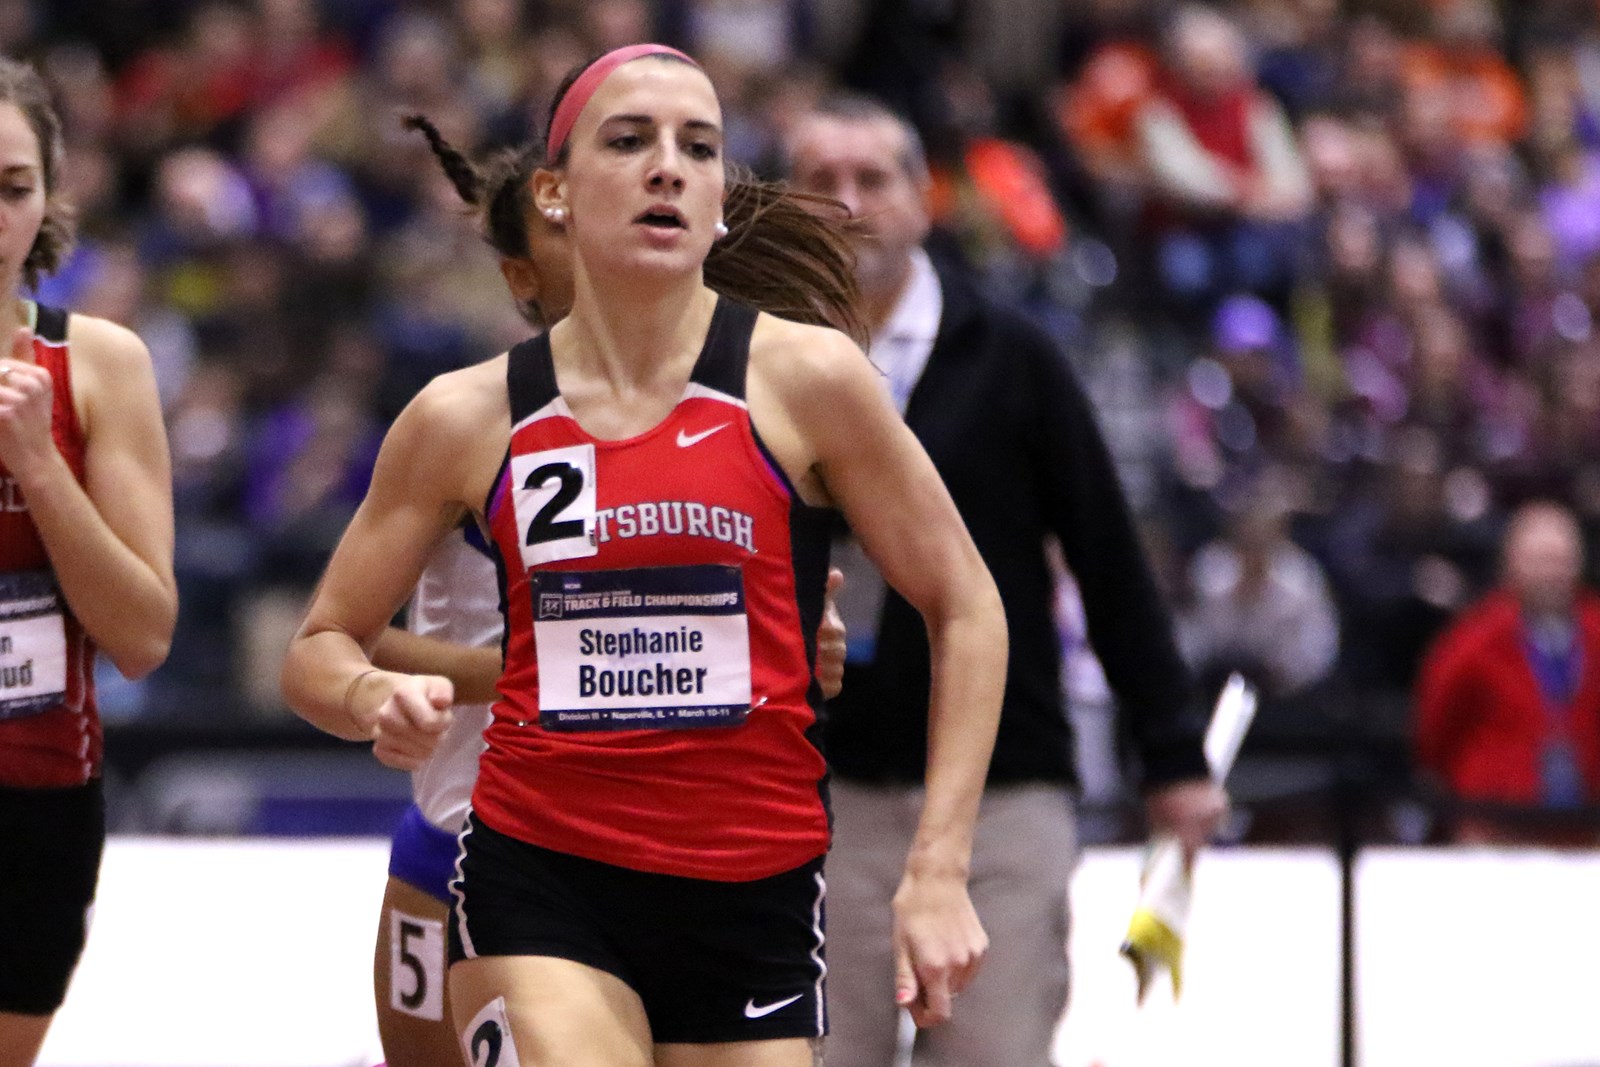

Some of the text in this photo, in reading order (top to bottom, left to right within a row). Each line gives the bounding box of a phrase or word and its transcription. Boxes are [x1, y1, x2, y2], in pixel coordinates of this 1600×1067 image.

[523, 462, 585, 547] 2
[596, 501, 754, 552] TSBURGH
[564, 598, 601, 611] TRACK
[612, 595, 642, 608] FIELD
[645, 592, 739, 606] CHAMPIONSHIPS
[579, 626, 703, 658] Stephanie
[579, 663, 707, 698] Boucher
[558, 713, 591, 721] Division
[678, 709, 705, 718] March
[707, 708, 731, 717] 10-11
[401, 921, 427, 1009] 5
